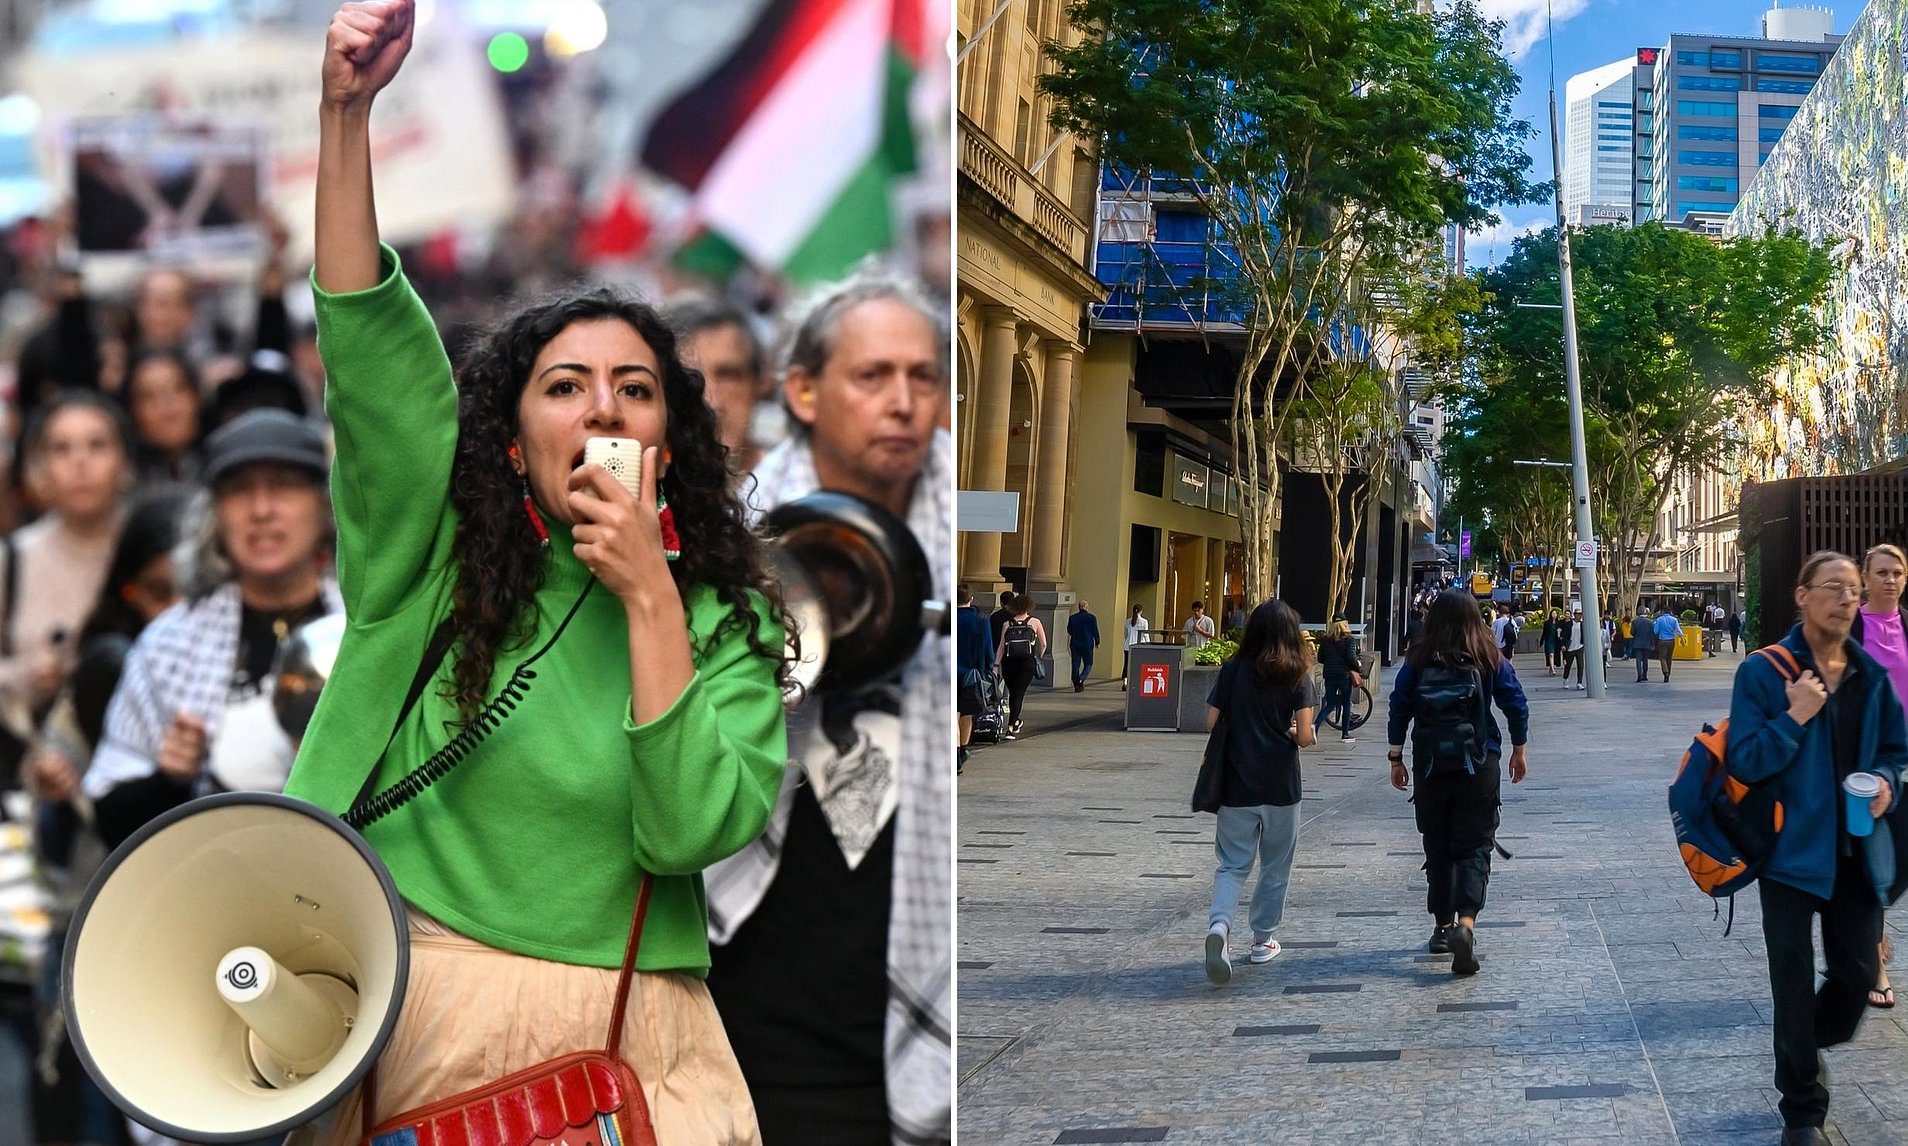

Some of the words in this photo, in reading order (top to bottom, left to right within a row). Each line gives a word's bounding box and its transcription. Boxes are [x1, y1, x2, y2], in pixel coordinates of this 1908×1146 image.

[1591, 207, 1631, 218] Heritag
[966, 237, 1001, 270] NATIONAL
[1041, 287, 1055, 305] BANK
